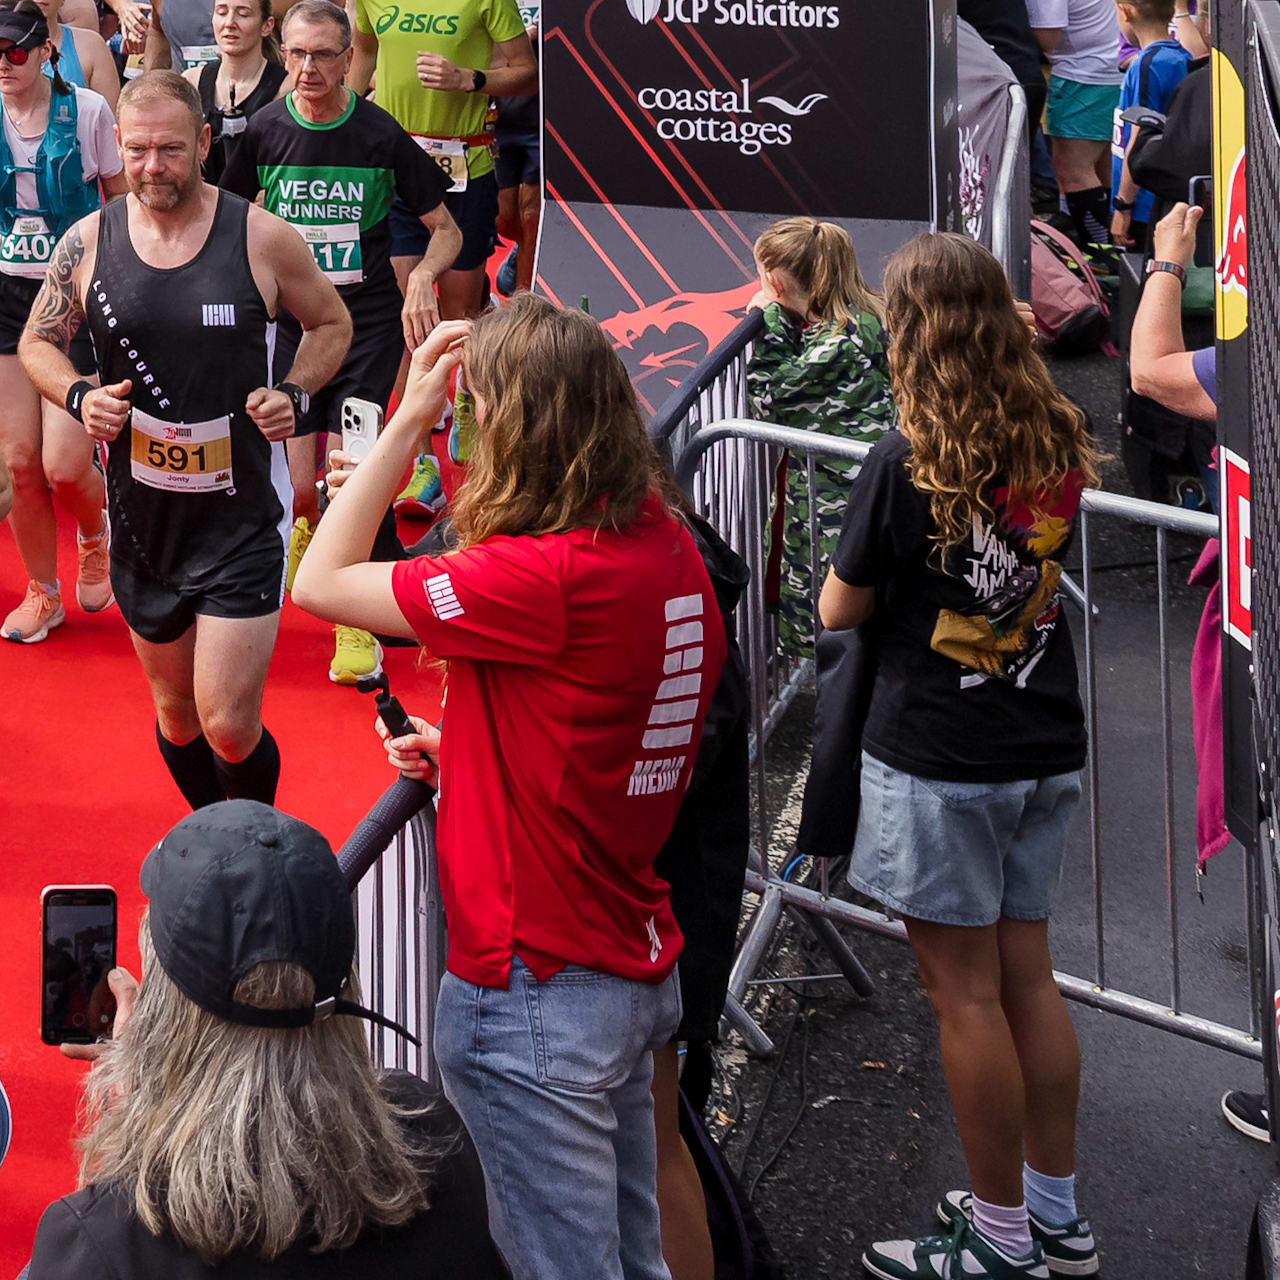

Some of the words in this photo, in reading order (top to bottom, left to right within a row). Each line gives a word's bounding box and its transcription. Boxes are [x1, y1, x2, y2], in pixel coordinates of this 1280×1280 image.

[398, 12, 460, 37] asics
[637, 79, 753, 116] coastal
[656, 117, 792, 156] cottages
[278, 179, 365, 203] VEGAN
[278, 201, 363, 221] RUNNERS
[92, 279, 119, 329] LONG
[119, 336, 171, 410] COURSE
[147, 439, 207, 472] 591
[167, 474, 190, 484] Jonty
[626, 755, 686, 797] MEDIA
